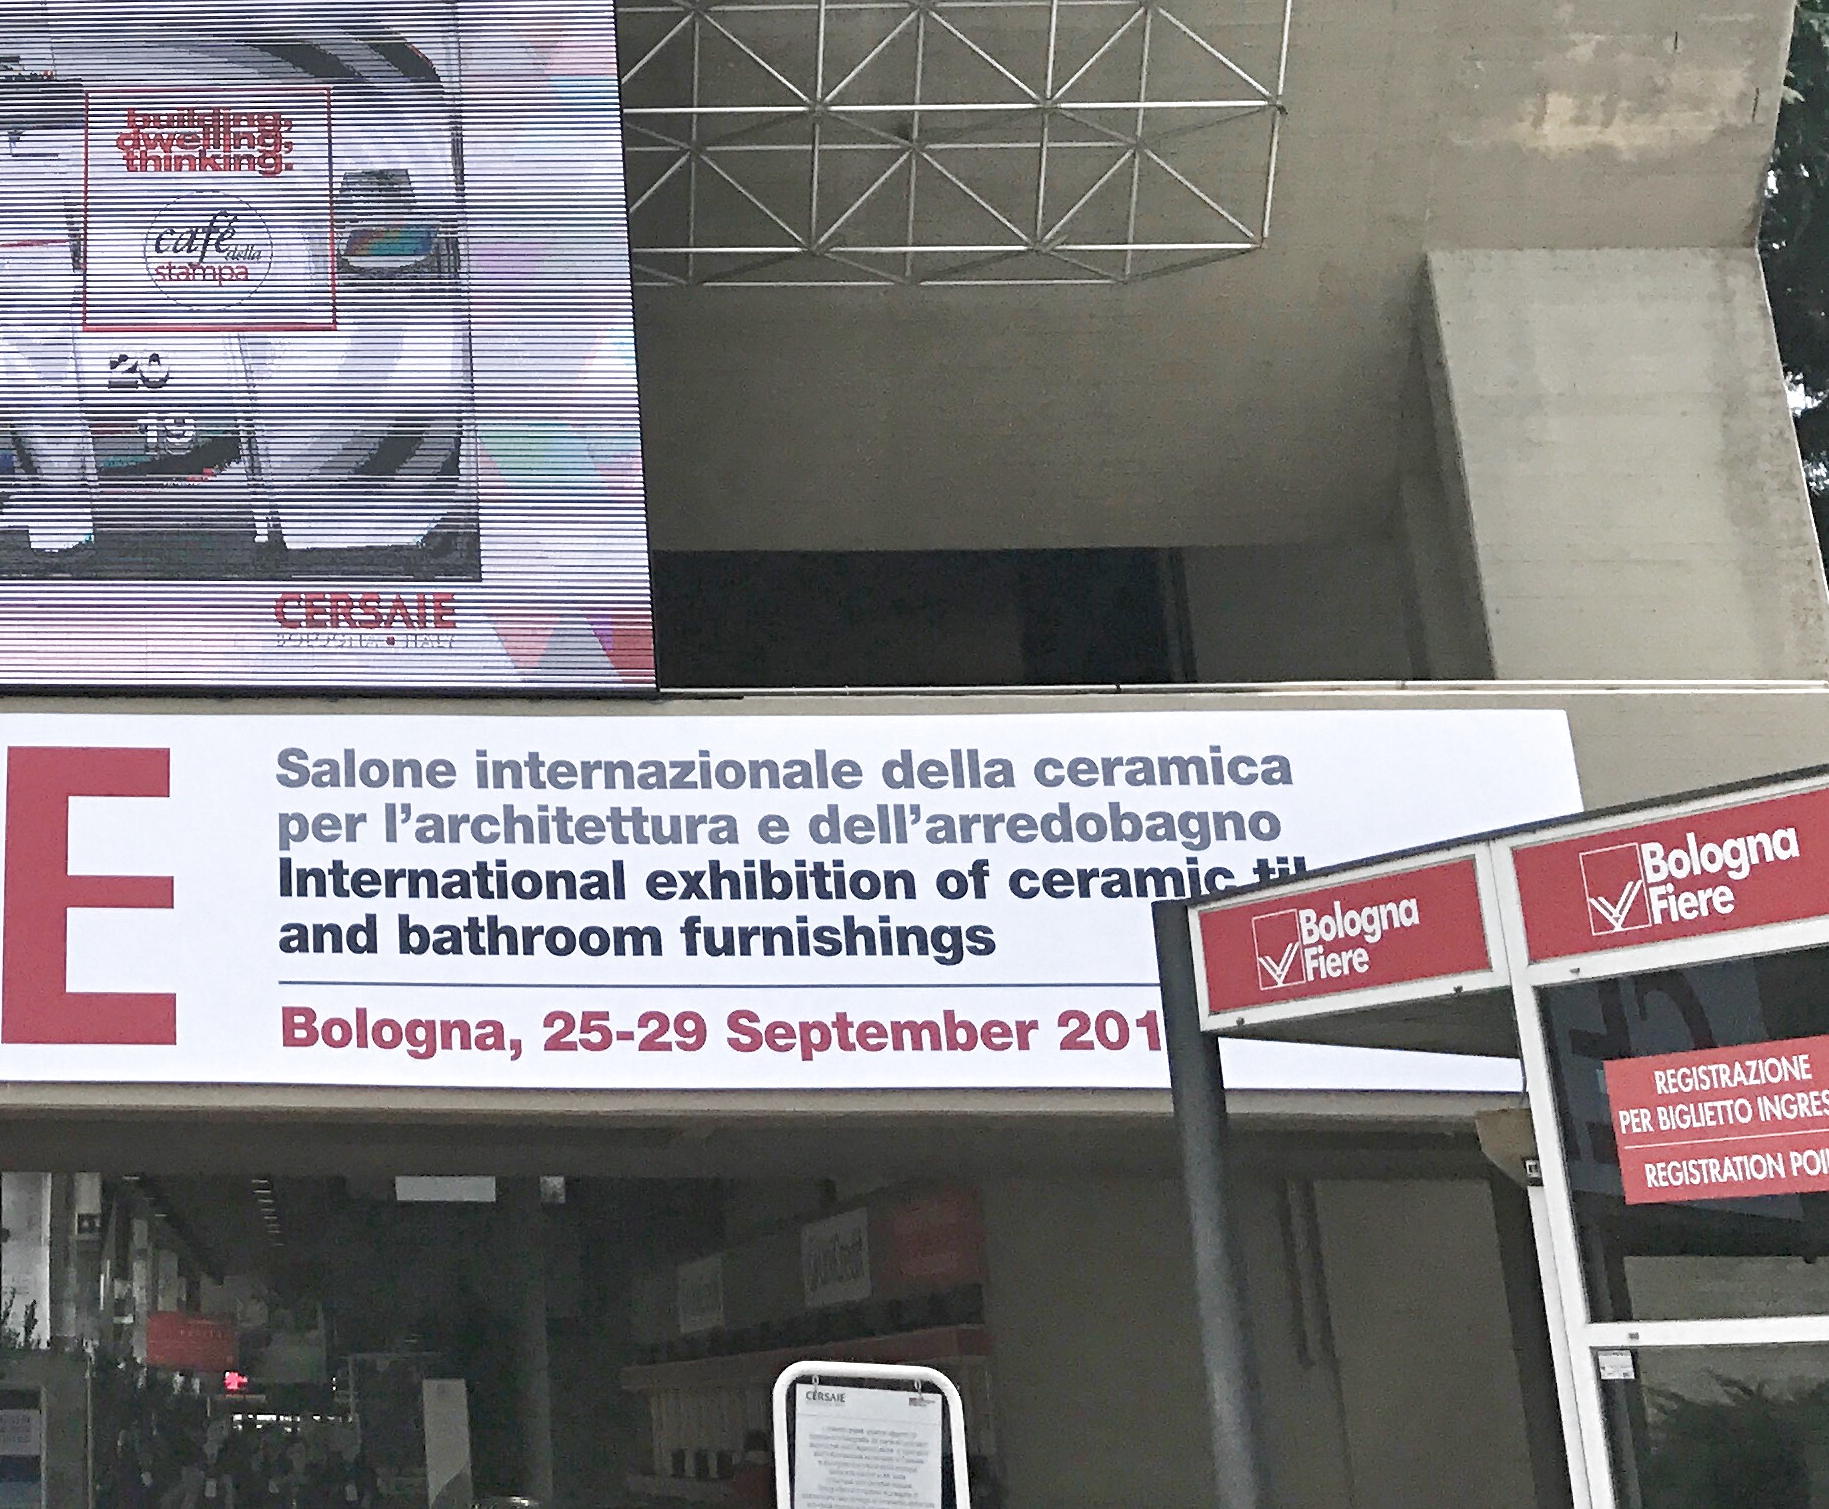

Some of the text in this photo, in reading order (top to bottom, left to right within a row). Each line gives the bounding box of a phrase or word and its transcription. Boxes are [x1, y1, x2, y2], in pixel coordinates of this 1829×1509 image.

[126, 107, 293, 132] building,
[116, 125, 293, 154] dwelling,
[122, 149, 294, 178] thinking.
[154, 209, 239, 264] café
[225, 244, 263, 261] della
[154, 261, 249, 287] stampa
[275, 591, 457, 629] CERSAIE
[276, 746, 1293, 790] Salone internazionale della ceramica
[279, 801, 1282, 852] per l'architettura e dell'arredobagno
[1641, 827, 1800, 880] Bologna
[280, 856, 1306, 900] International exhibition of ceramic til
[1298, 898, 1420, 944] Bologna
[1648, 882, 1735, 925] Fiere
[279, 913, 996, 966] and bathroom furnishings
[1304, 944, 1370, 981] Fiere
[282, 1005, 1161, 1061] Bologna, 25-29 September 201
[1653, 1054, 1812, 1095] REGISTRAZIONE
[1618, 1108, 1655, 1135] PER
[1657, 1098, 1753, 1131] BIGLIETTO
[1644, 1152, 1786, 1188] REGISTRATION
[805, 1391, 846, 1403] CERSAIE
